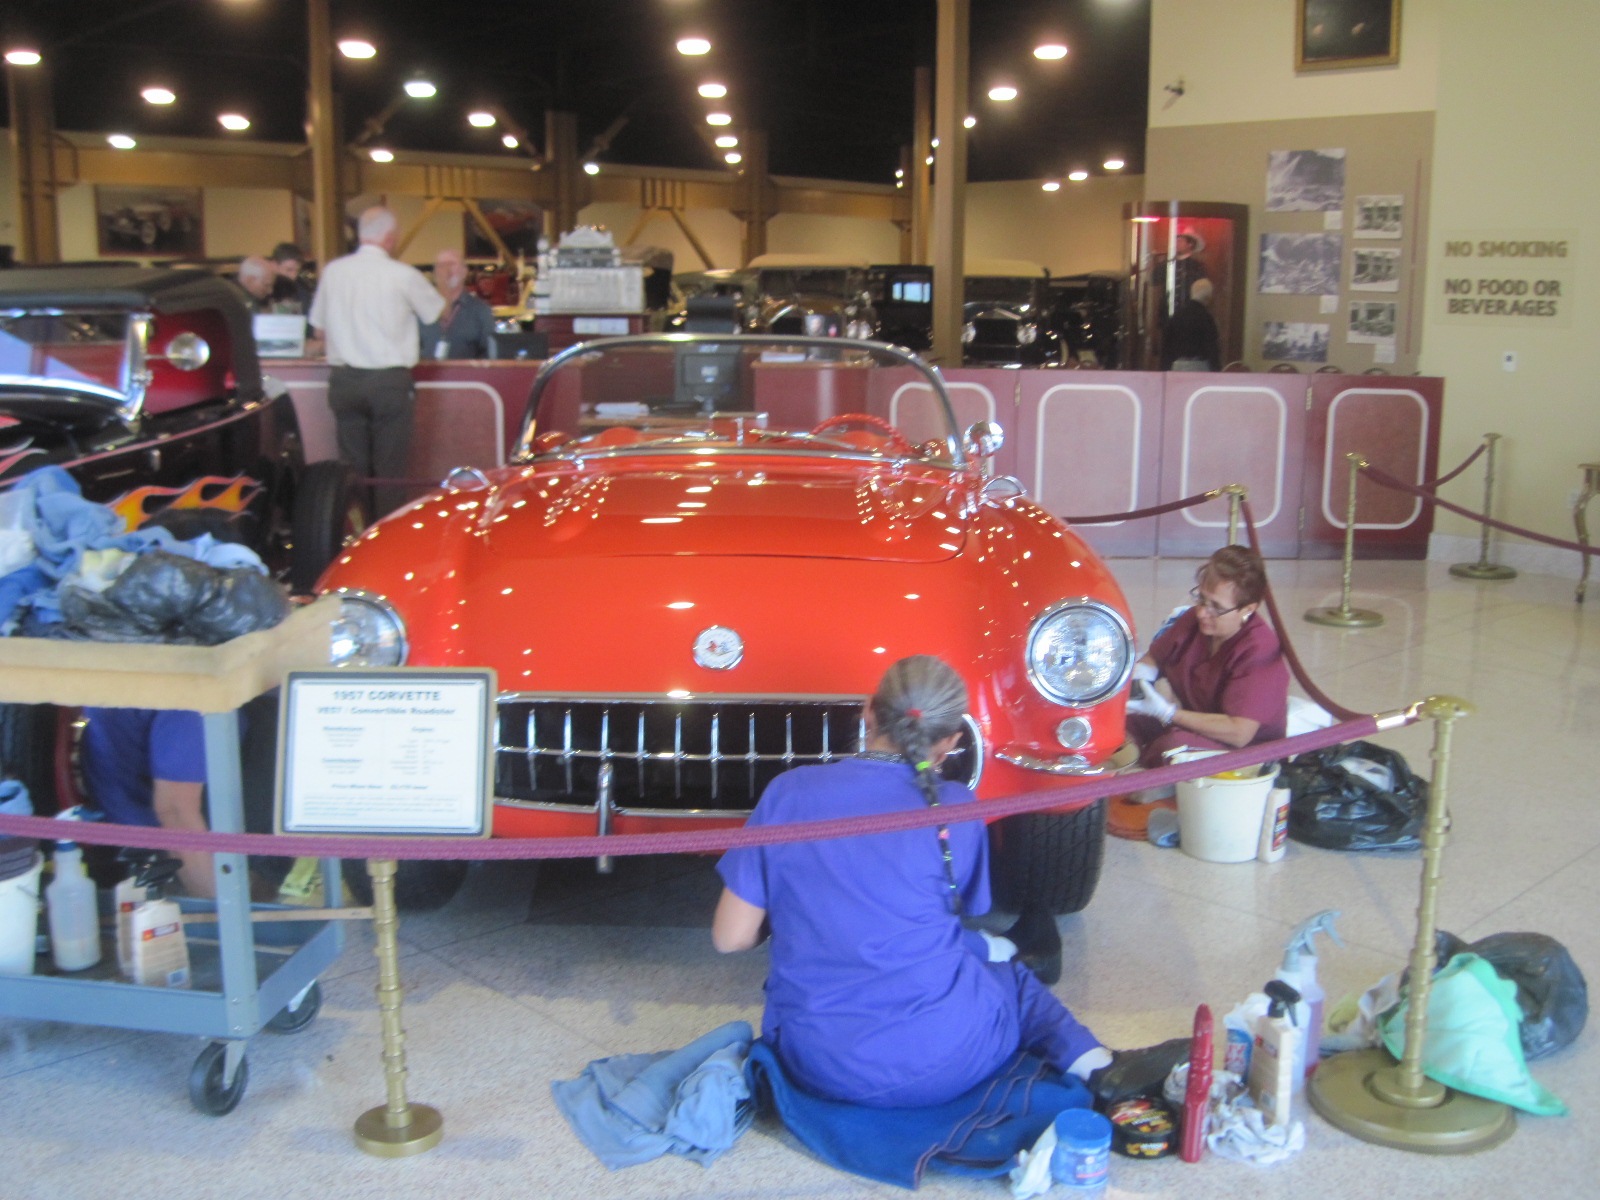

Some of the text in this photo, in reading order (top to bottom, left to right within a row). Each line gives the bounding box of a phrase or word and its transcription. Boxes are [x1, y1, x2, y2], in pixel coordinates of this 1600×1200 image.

[1445, 241, 1568, 258] NO SMOKING
[1444, 279, 1561, 296] NO FOOD OR
[1447, 298, 1557, 316] BEVERAGES
[332, 690, 442, 702] 1957 CORVETTE
